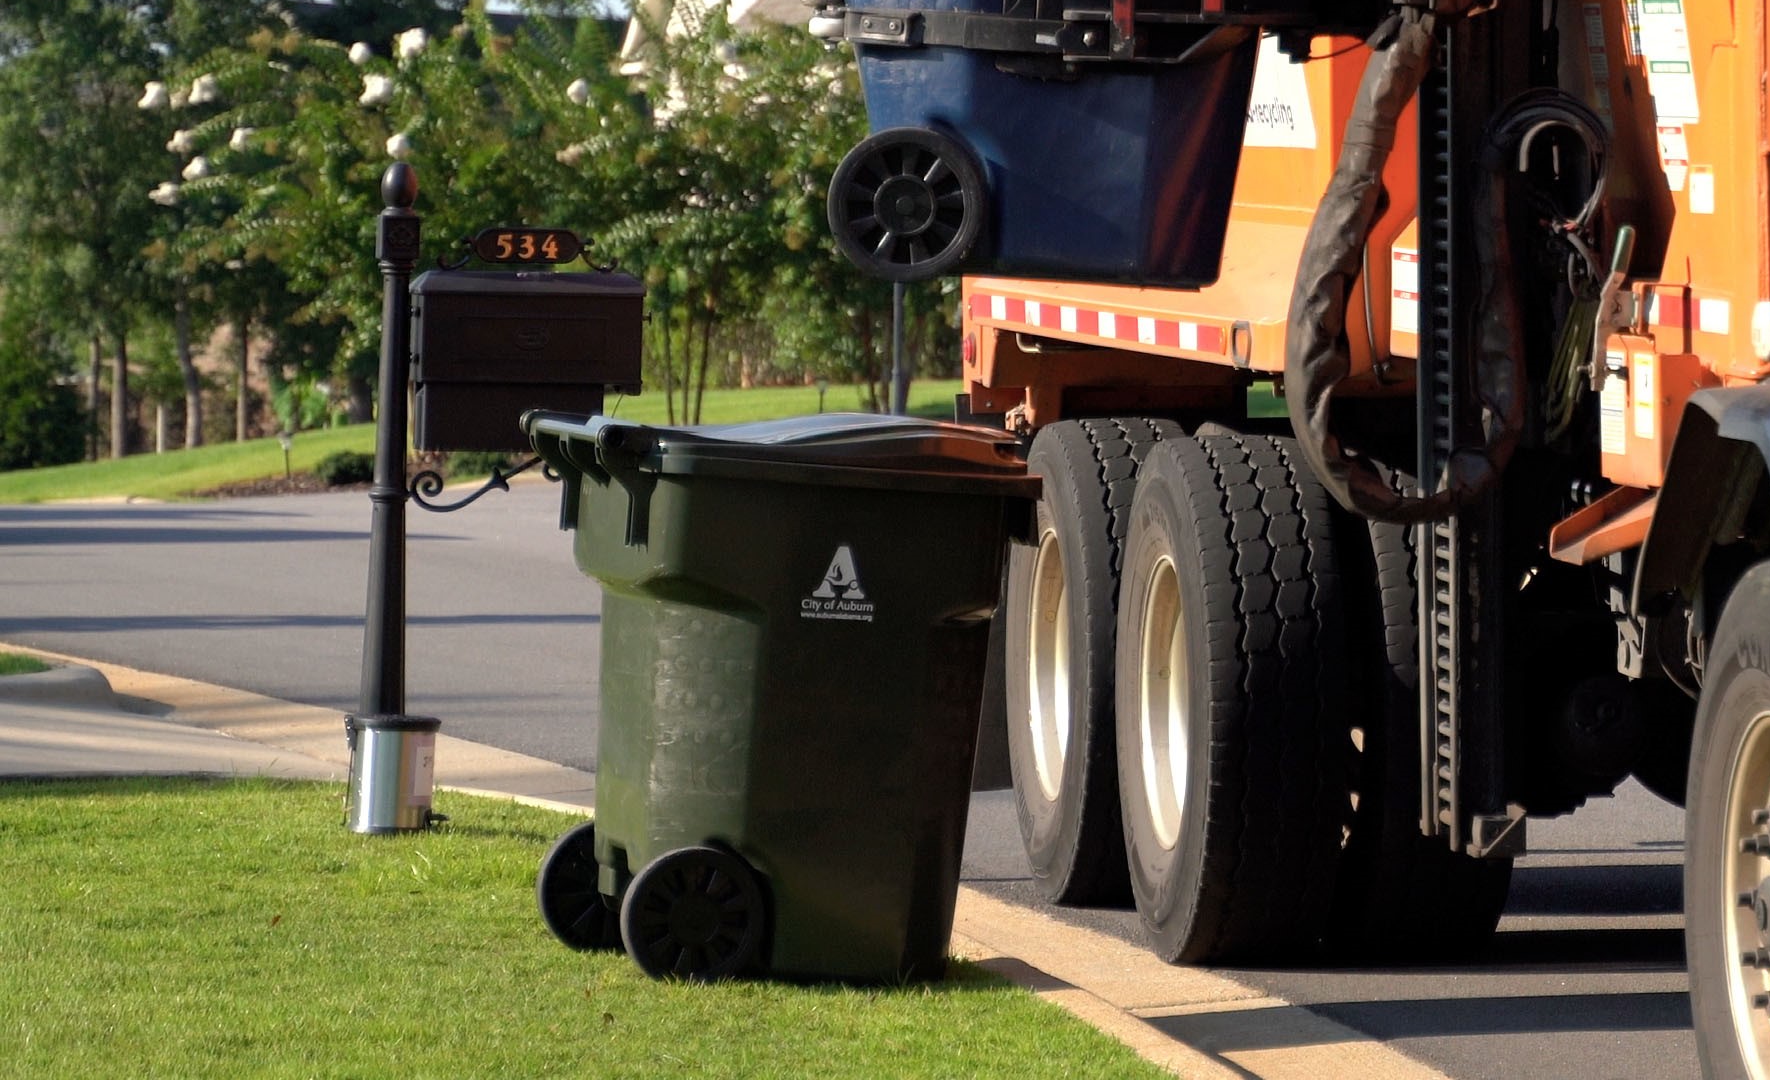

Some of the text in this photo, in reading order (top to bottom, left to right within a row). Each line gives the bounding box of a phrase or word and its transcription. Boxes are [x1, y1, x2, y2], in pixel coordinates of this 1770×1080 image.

[495, 233, 558, 259] 534
[801, 599, 874, 612] City of Auburn
